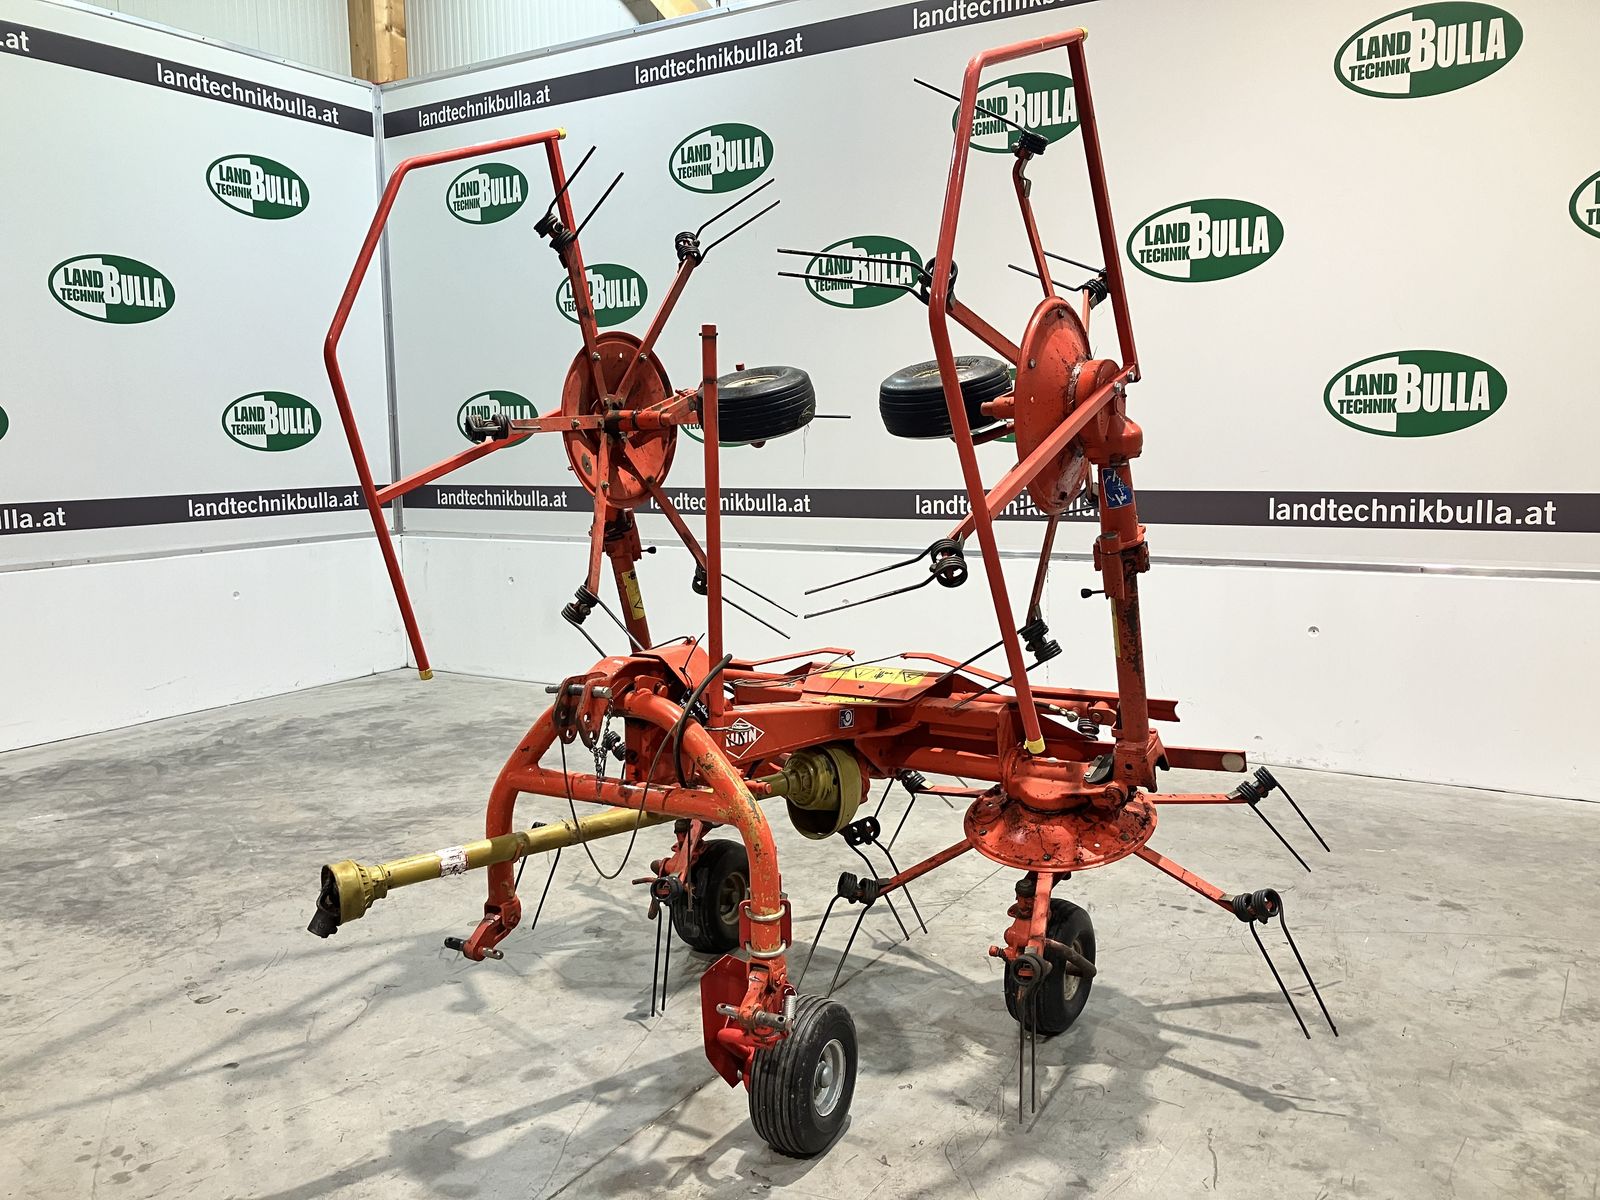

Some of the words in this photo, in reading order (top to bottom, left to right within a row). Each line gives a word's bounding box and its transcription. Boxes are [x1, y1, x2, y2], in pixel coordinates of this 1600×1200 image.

[1356, 31, 1411, 62] LAND
[1410, 17, 1507, 73] BULLA
[635, 32, 803, 85] landtechnikbulla.at
[1349, 57, 1411, 82] TECHNIK
[156, 62, 339, 125] landtechnikbulla.at
[418, 85, 551, 128] landtechnikbulla.at
[974, 96, 1008, 120] AND
[1008, 86, 1078, 132] BULLA
[680, 143, 711, 165] LAND
[711, 134, 765, 175] BULLA
[218, 164, 251, 186] LAND
[677, 163, 712, 180] TECHNIK
[215, 182, 253, 200] TECHNIK
[250, 164, 303, 208] BULLA
[455, 180, 480, 199] LAND
[479, 172, 522, 208] BULLA
[453, 198, 480, 212] TECHNIK
[1144, 222, 1190, 246] LAND
[1190, 212, 1270, 260] BULLA
[1138, 245, 1191, 264] TECHNIK
[63, 267, 104, 288] LAND
[102, 264, 167, 308] BULLA
[60, 288, 106, 304] TECHNIK
[592, 273, 641, 310] BULLA
[1344, 372, 1398, 396] LAND
[1397, 363, 1491, 413] BULLA
[233, 406, 265, 422] LAND
[264, 400, 315, 435] BULLA
[1338, 397, 1397, 414] TECHNIK
[231, 423, 266, 435] TECHNIK
[188, 490, 360, 518] landtechnikbulla.at
[436, 489, 568, 508] landtechnikbulla.at
[1268, 497, 1557, 527] landtechnikbulla.at
